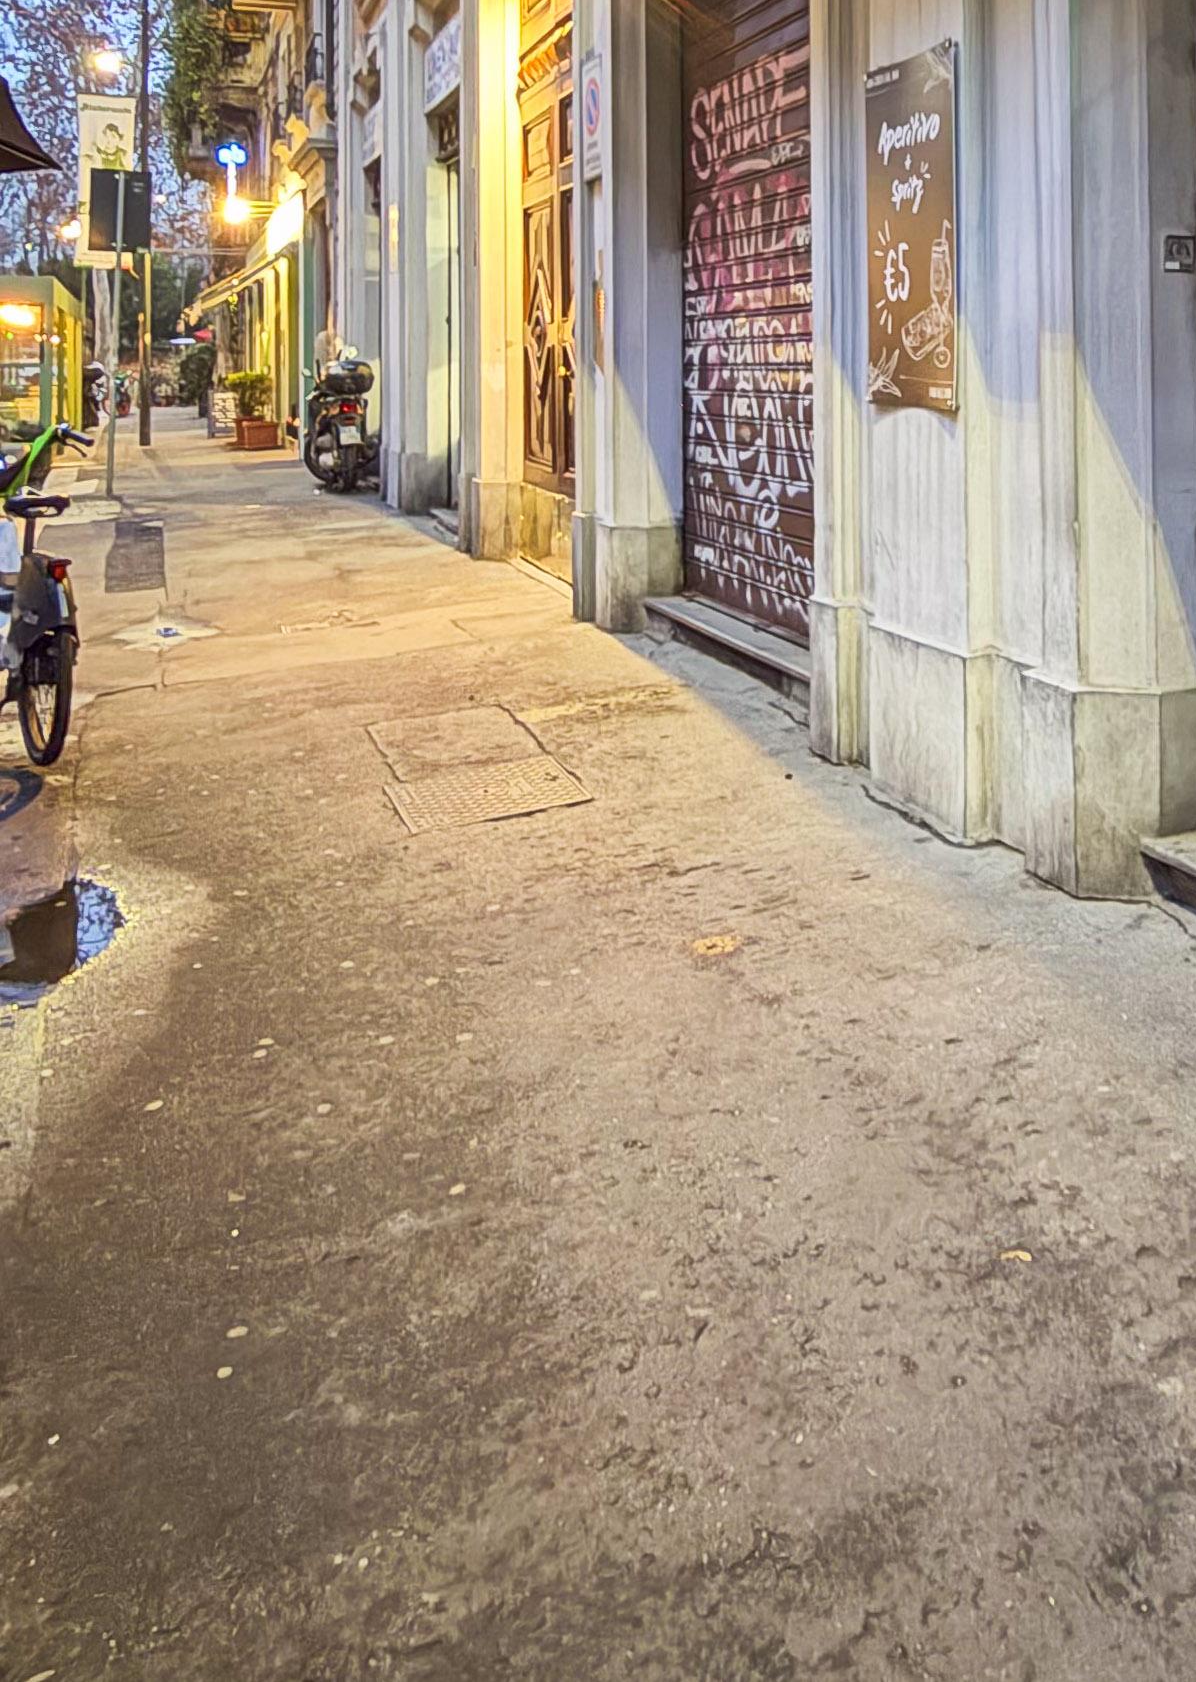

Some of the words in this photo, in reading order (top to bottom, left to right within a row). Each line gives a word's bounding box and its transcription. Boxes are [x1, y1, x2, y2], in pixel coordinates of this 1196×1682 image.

[878, 112, 940, 165] Aperitivo
[891, 175, 924, 214] Spritz
[884, 241, 910, 303] €5
